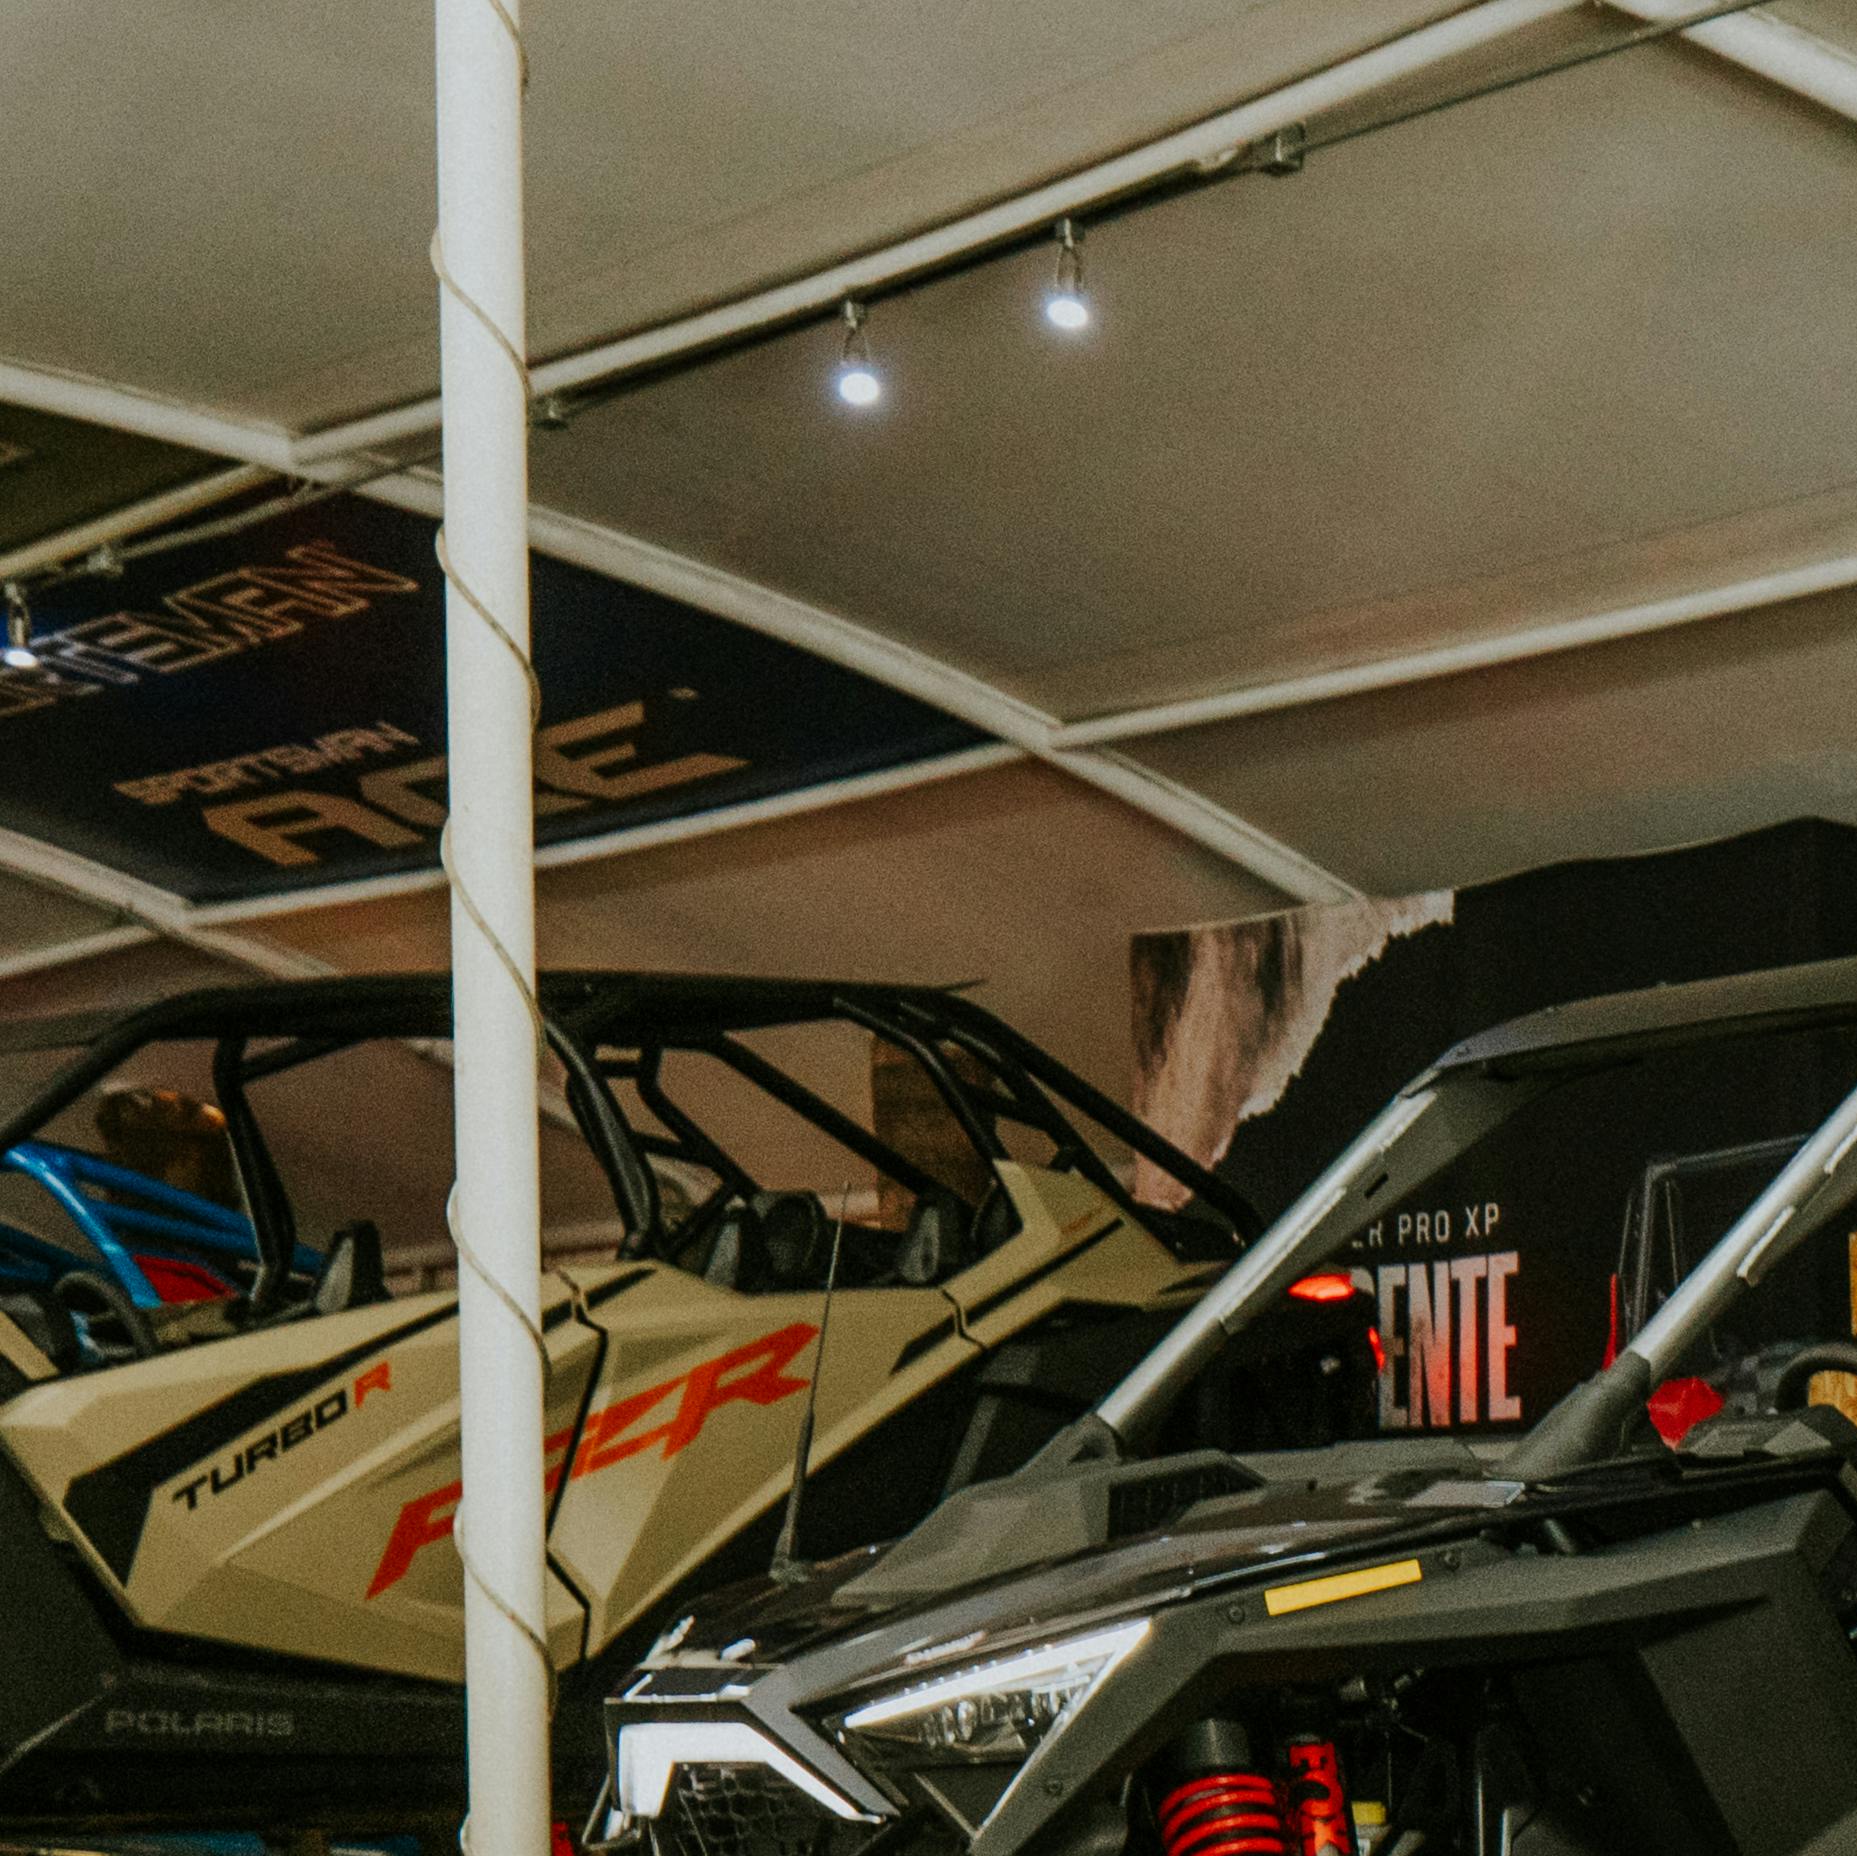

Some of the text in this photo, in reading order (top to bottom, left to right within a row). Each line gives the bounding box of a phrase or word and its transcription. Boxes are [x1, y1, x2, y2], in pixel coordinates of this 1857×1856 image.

[113, 720, 421, 805] SPORTSMAN
[1397, 1209, 1451, 1247] PRO
[1465, 1202, 1501, 1238] XP
[1351, 1250, 1522, 1431] ENTE
[171, 1388, 350, 1510] TURBO
[104, 1708, 294, 1737] POLARIS
